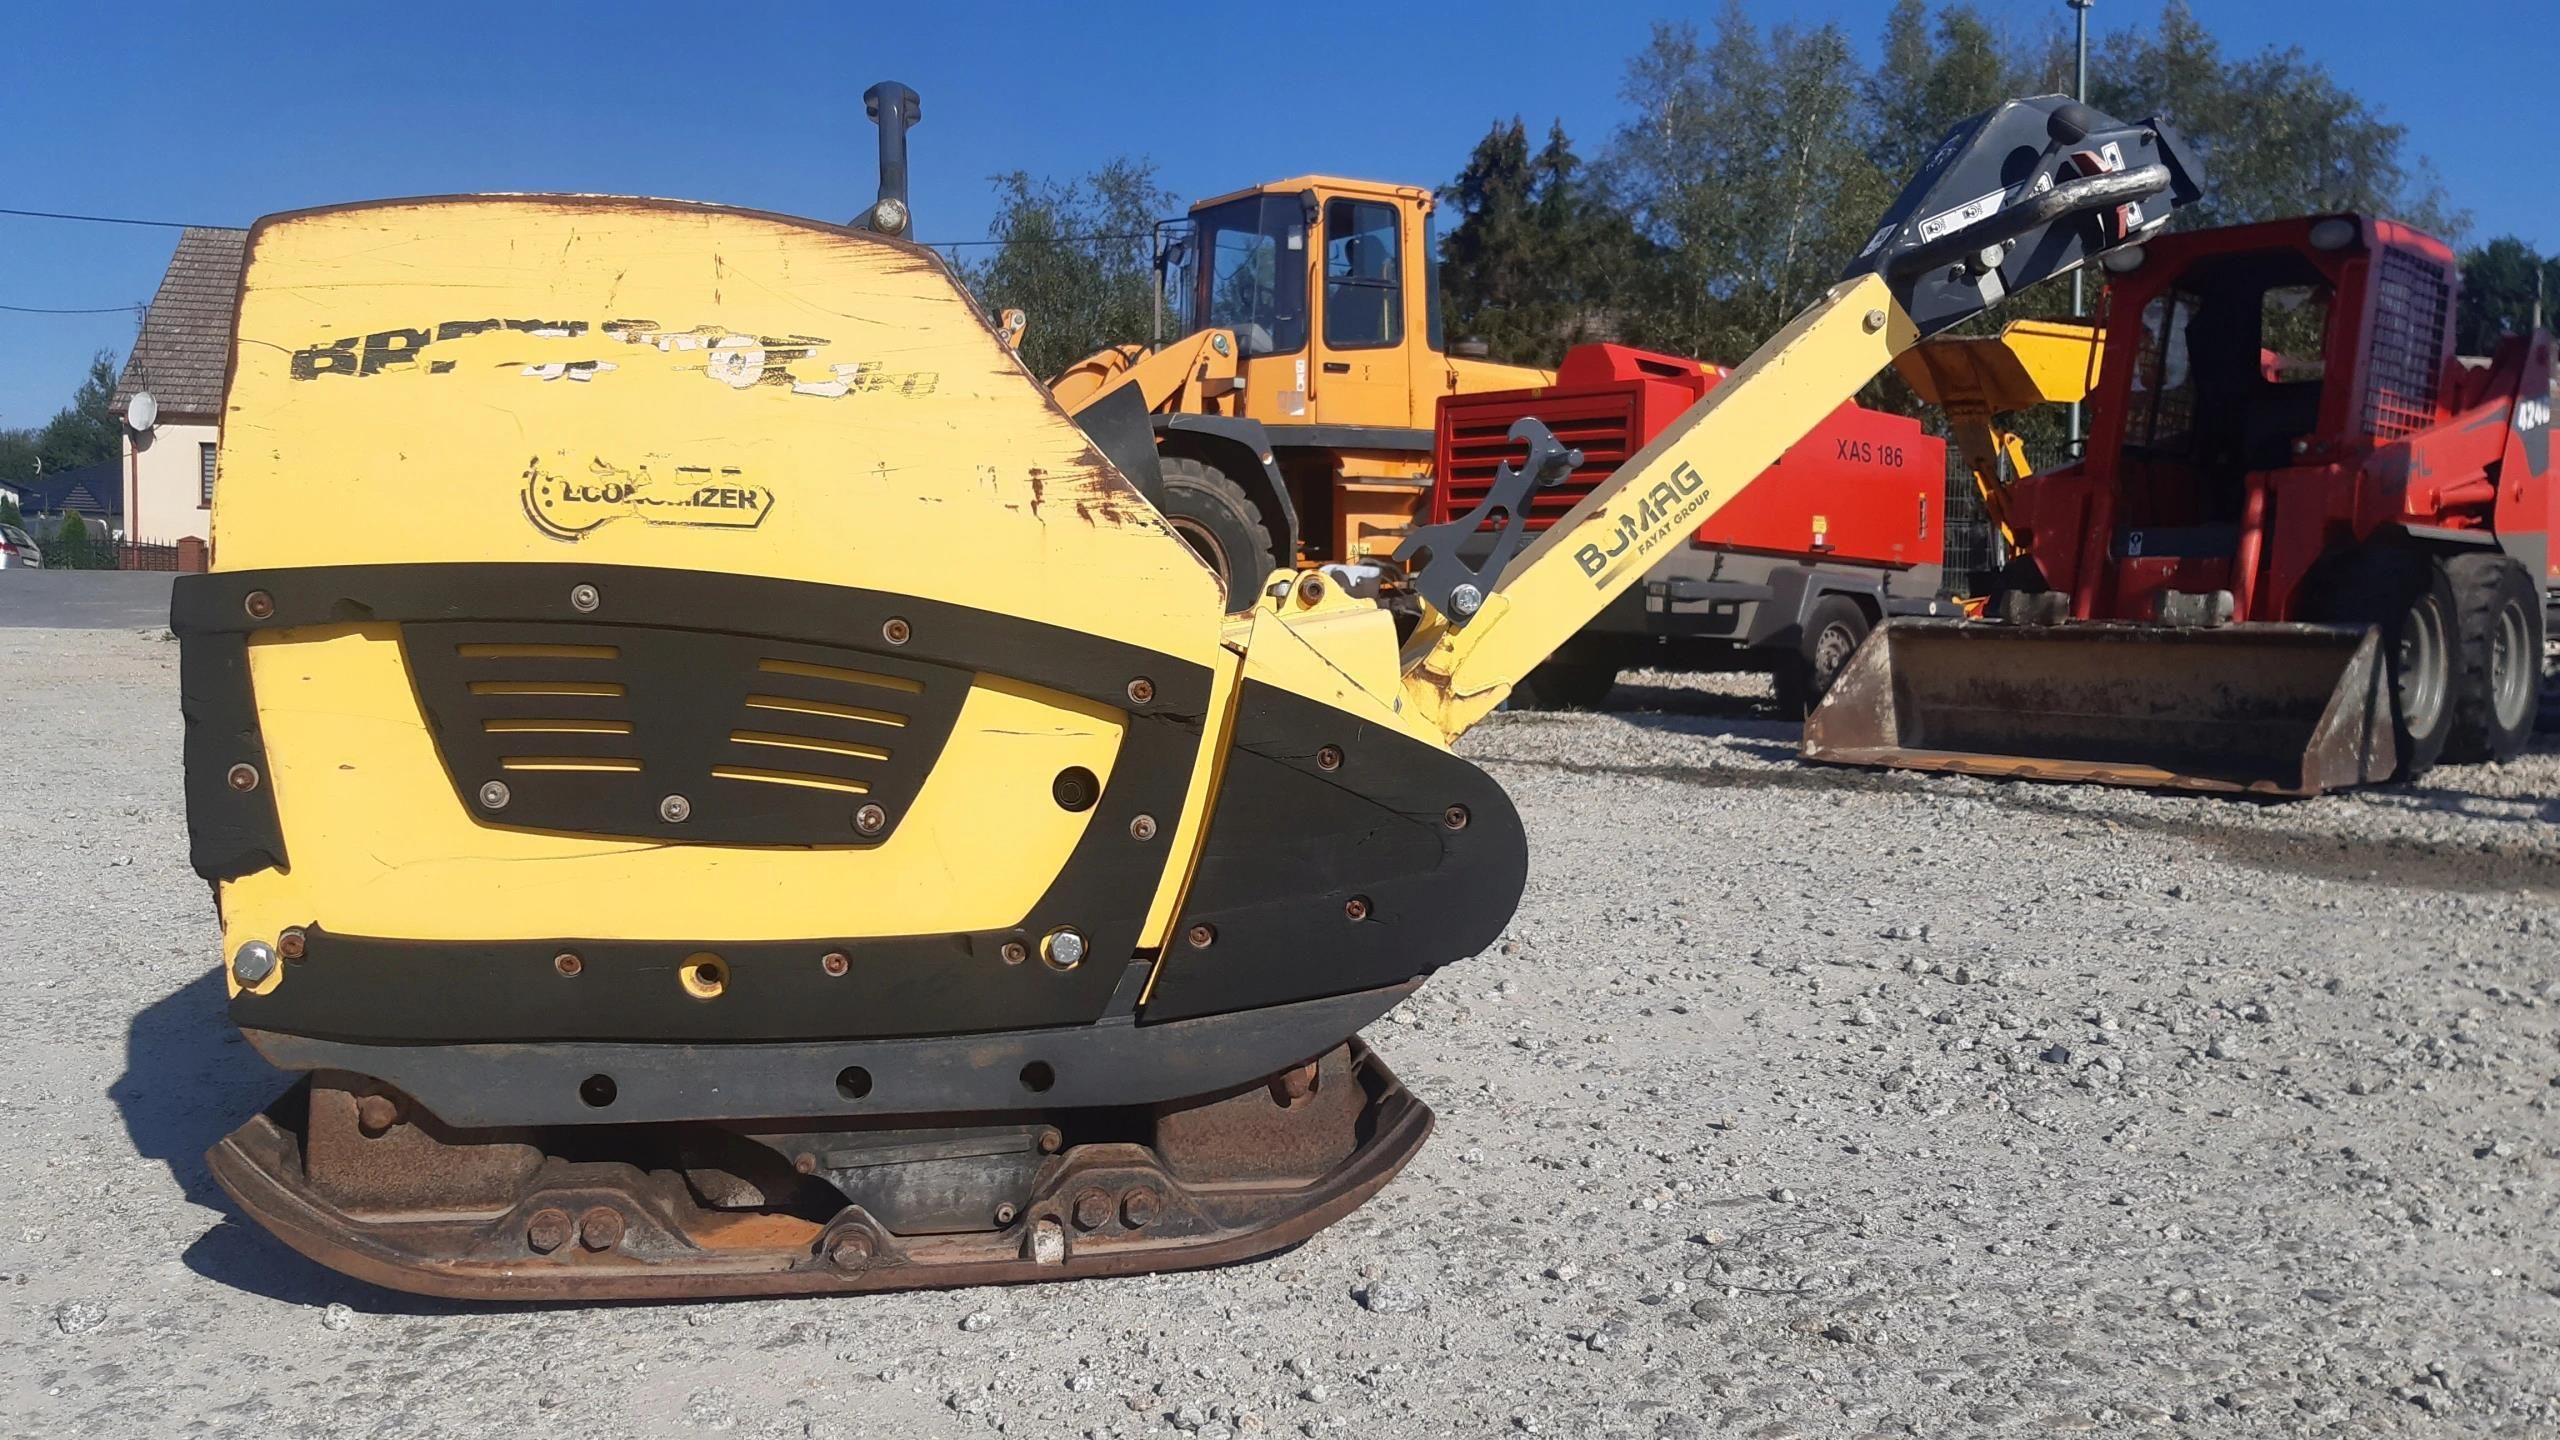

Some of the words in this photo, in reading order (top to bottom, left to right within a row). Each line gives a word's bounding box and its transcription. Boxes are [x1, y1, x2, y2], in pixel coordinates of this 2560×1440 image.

[1836, 439, 1872, 463] XAS
[1877, 445, 1904, 468] 186
[1637, 522, 1672, 556] FAYAT
[1673, 489, 1711, 525] GROUP
